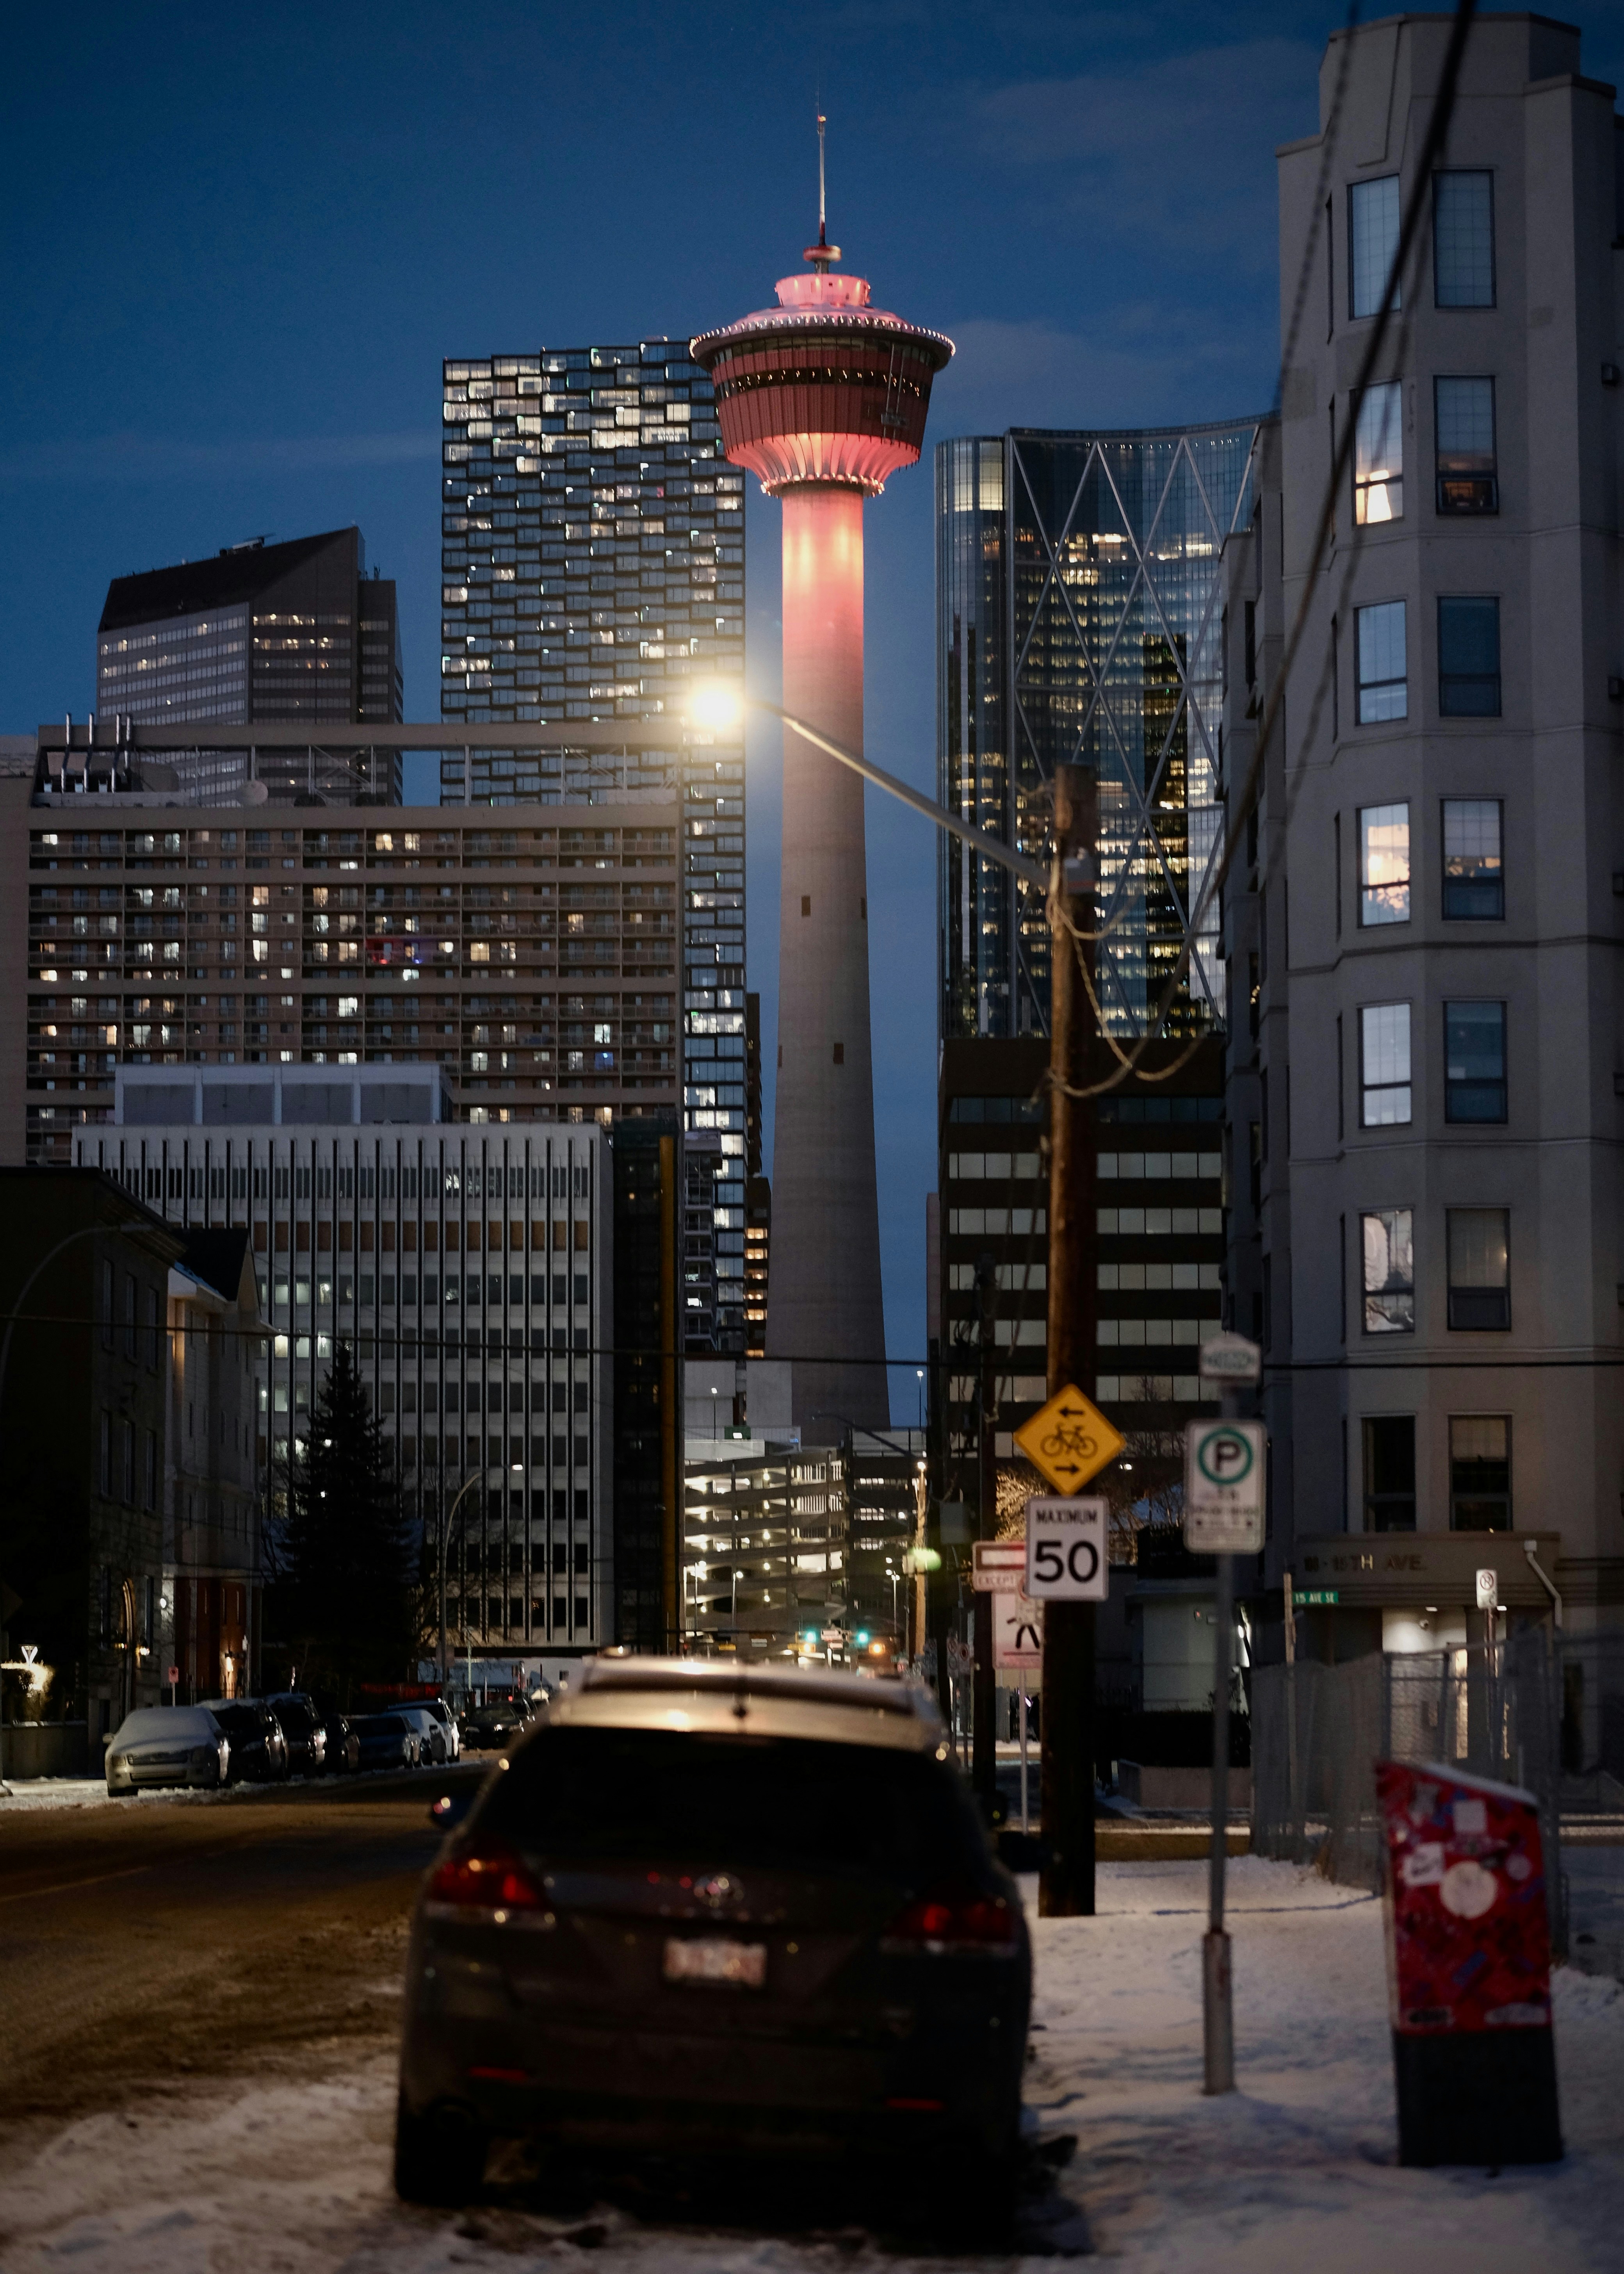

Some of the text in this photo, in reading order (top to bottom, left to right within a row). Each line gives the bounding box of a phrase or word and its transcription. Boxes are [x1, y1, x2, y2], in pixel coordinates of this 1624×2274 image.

[1036, 1509, 1097, 1524] MAXIMUM
[1035, 1540, 1099, 1583] 50
[978, 1576, 1014, 1585] EXCEPT
[1295, 1592, 1334, 1603] 15 AVE SE
